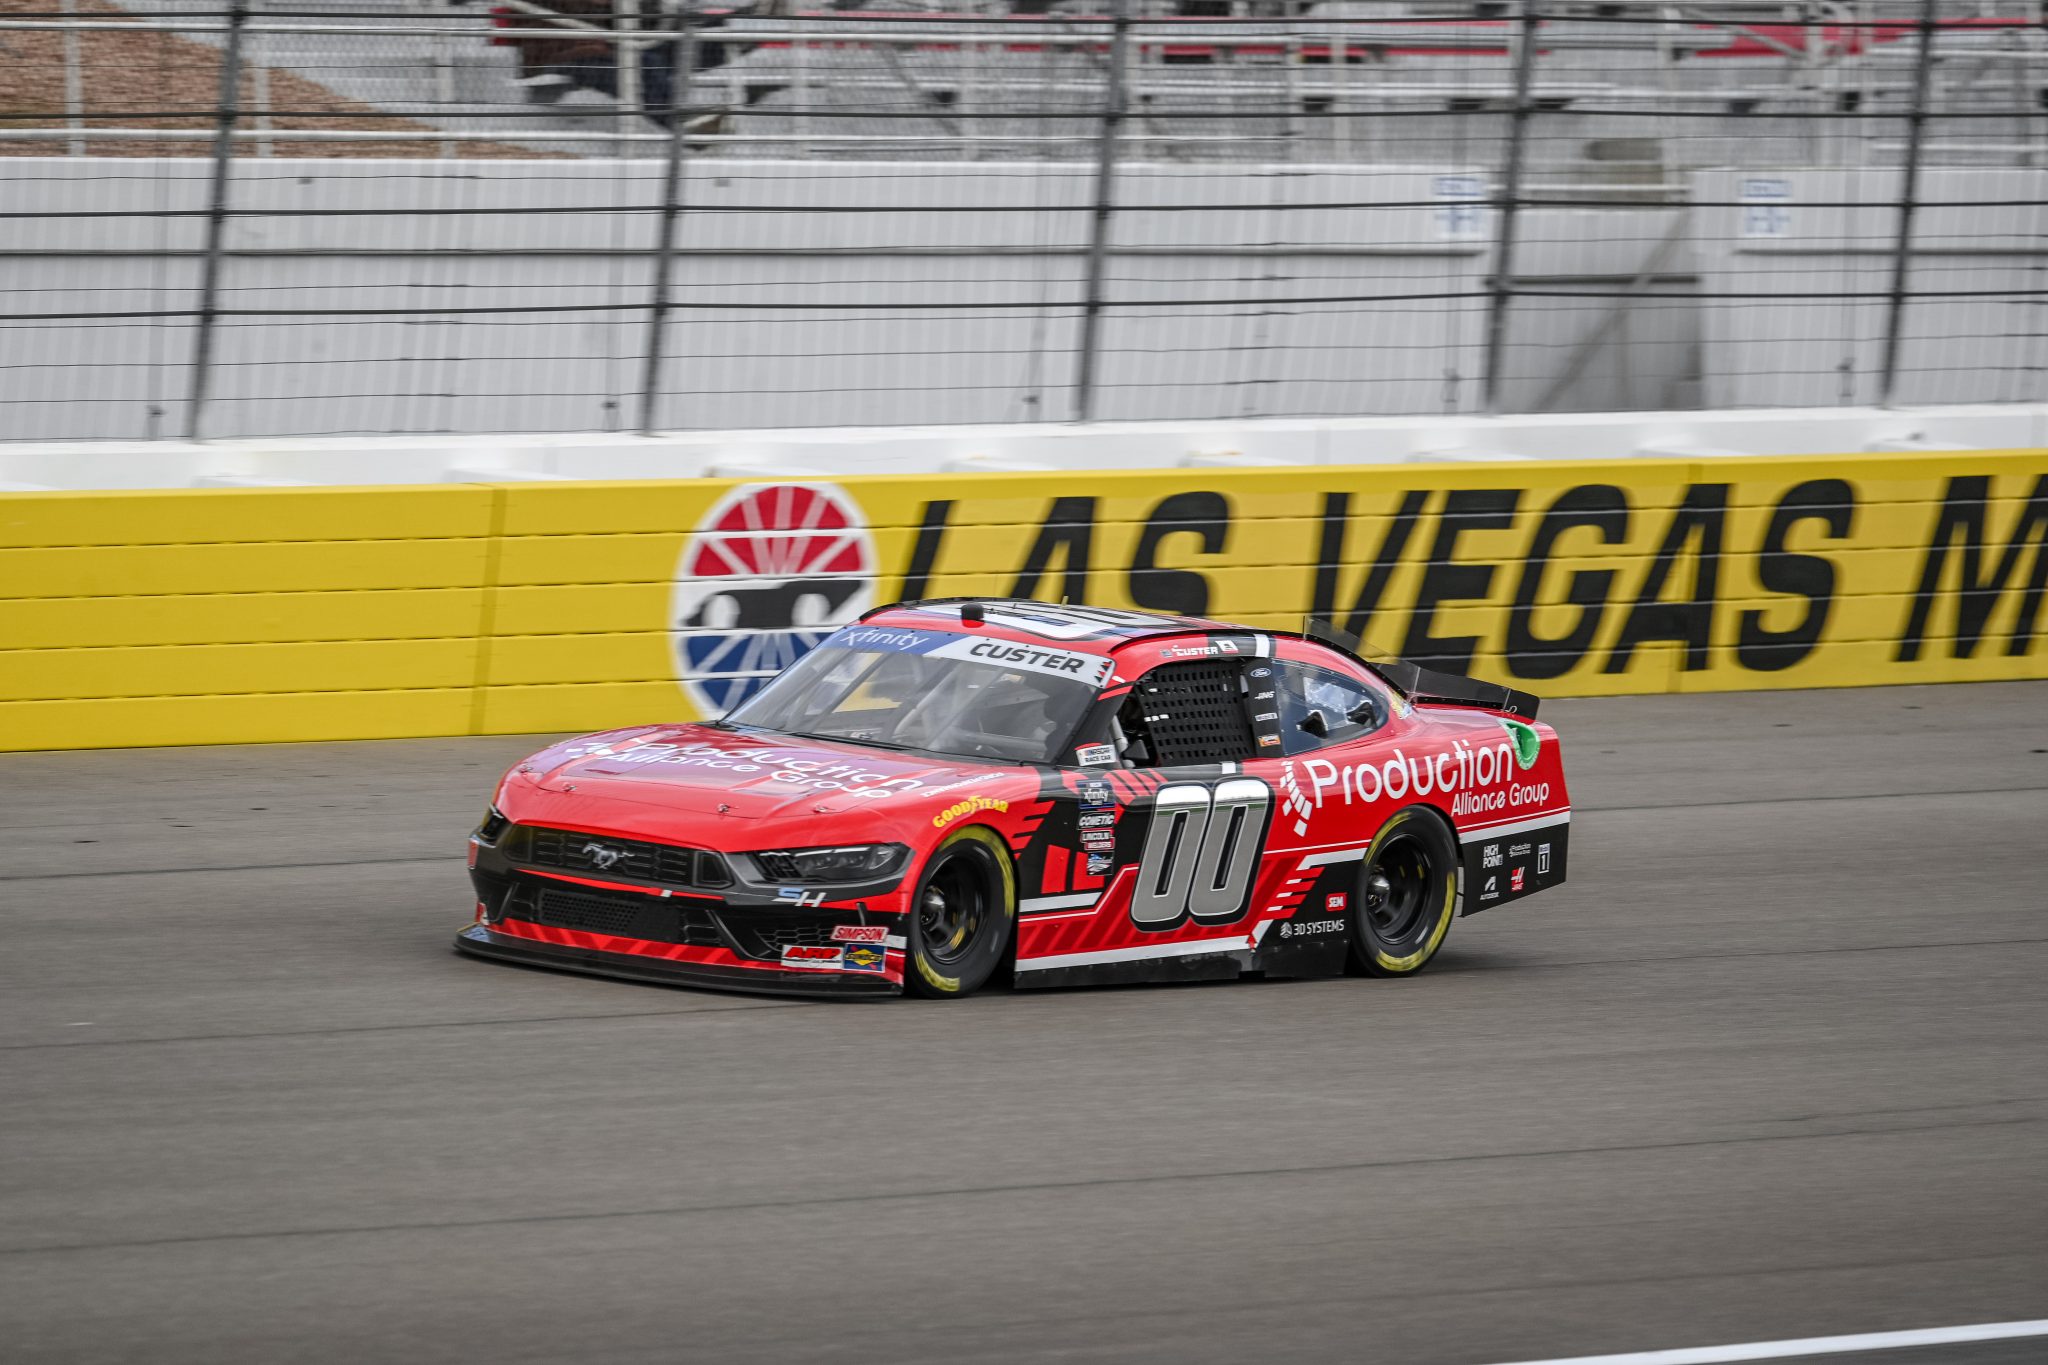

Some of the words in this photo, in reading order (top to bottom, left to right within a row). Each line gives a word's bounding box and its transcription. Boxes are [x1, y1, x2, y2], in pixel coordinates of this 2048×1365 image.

[1308, 478, 1860, 679] VEGAS
[840, 628, 931, 650] xfinity
[969, 643, 1085, 674] CUSTER
[606, 753, 761, 772] Alliance
[770, 770, 893, 799] Group
[1302, 739, 1512, 809] Production
[1450, 791, 1506, 817] Alliance
[1509, 782, 1549, 806] Group
[1131, 779, 1271, 924] 00
[835, 928, 885, 940] SIMPSON
[1293, 924, 1306, 935] 3D
[1306, 919, 1345, 935] SYSTEMS
[785, 947, 842, 959] ARP
